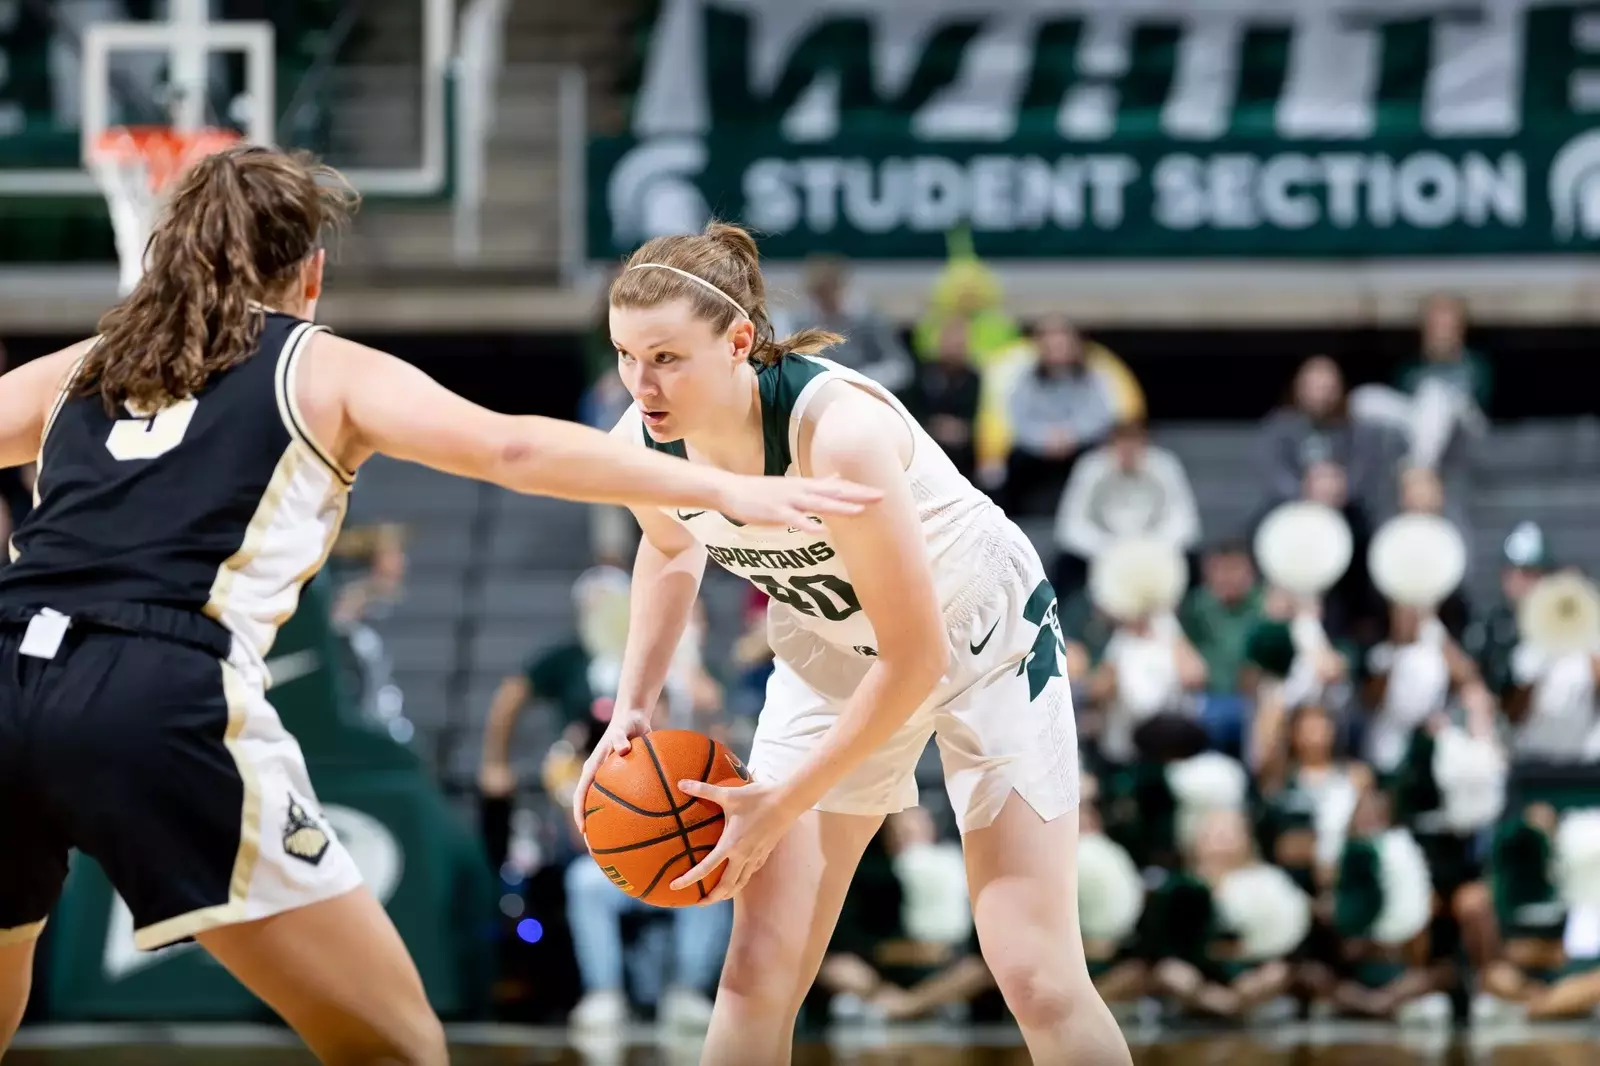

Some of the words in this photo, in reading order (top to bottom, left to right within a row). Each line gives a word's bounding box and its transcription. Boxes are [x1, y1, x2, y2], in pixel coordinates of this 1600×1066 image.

[742, 154, 1140, 233] STUDENT
[1152, 151, 1527, 229] SECTION
[705, 541, 836, 569] SPARTANS
[749, 573, 862, 621] 40
